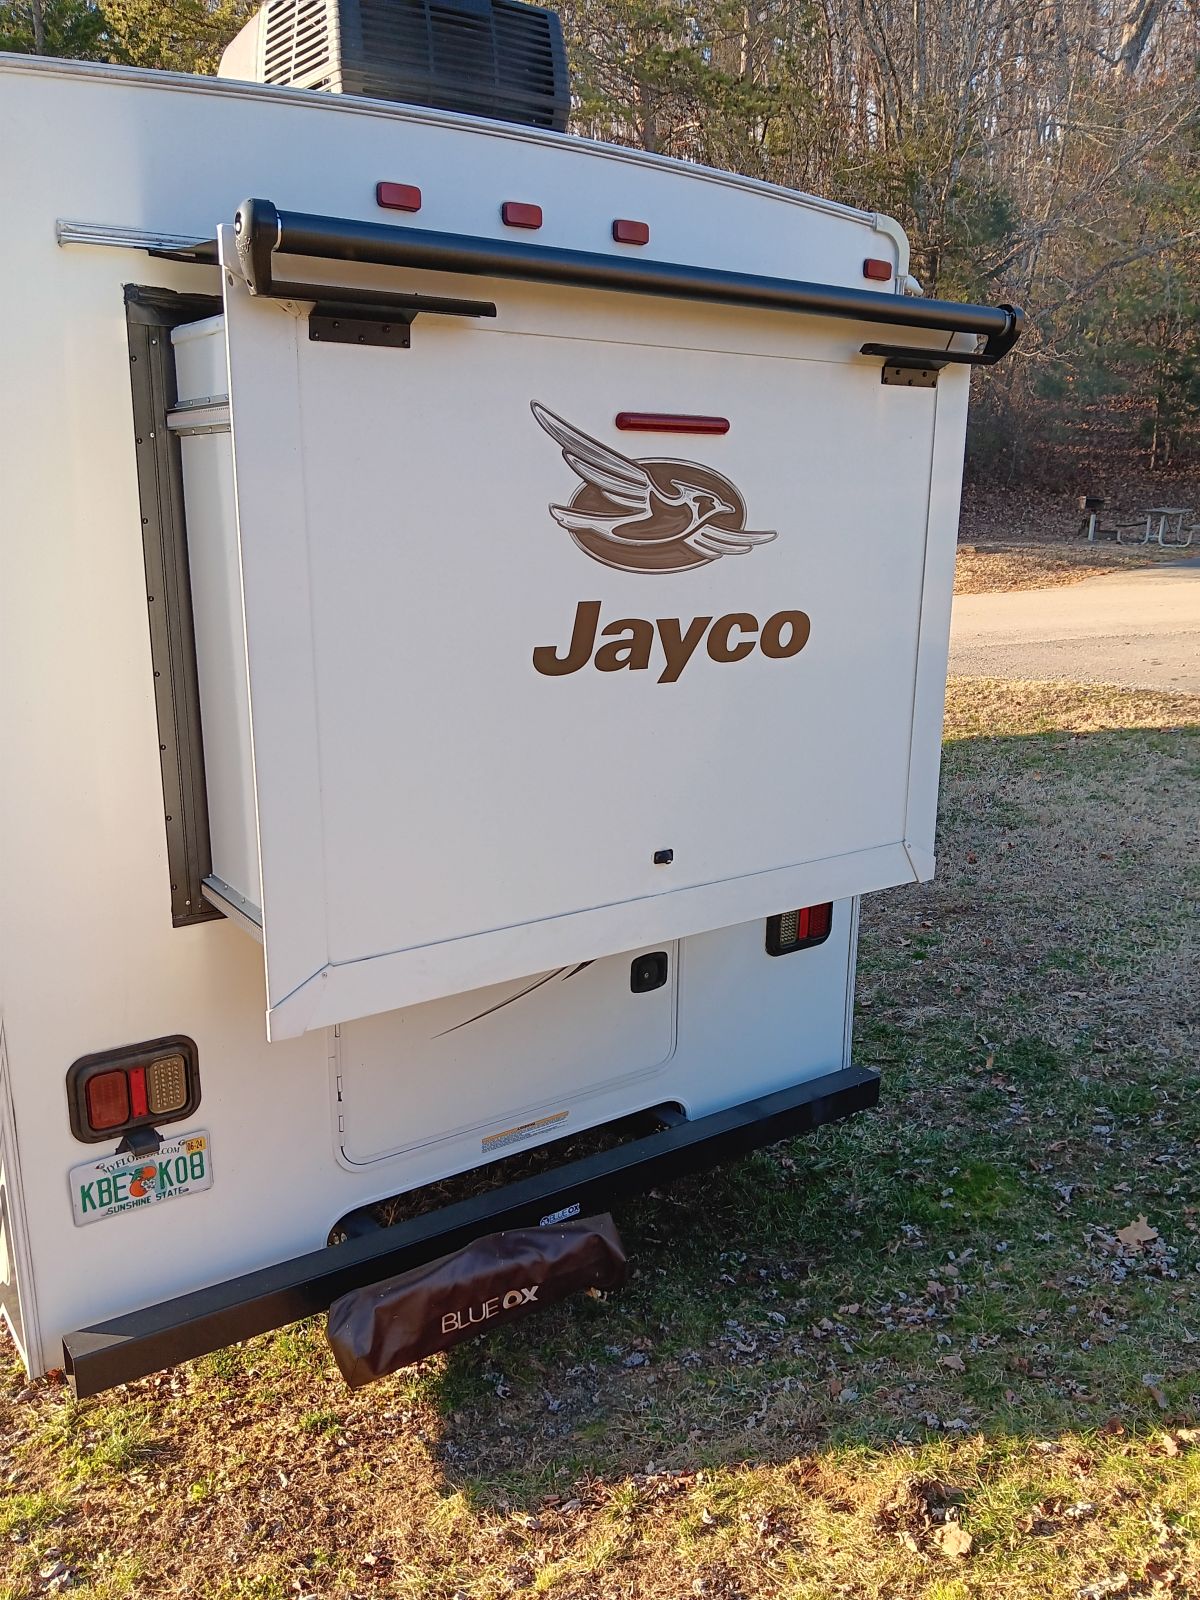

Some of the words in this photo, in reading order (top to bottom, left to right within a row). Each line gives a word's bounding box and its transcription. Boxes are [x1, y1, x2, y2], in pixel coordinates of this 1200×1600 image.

[532, 600, 811, 684] Jayco
[102, 1146, 181, 1176] MYFLO.COM
[80, 1172, 130, 1213] KBE
[107, 1196, 152, 1215] SUNSHINE
[155, 1187, 184, 1202] STATE
[567, 1204, 580, 1214] OX
[441, 1296, 500, 1334] BLUE
[502, 1285, 539, 1310] OX
